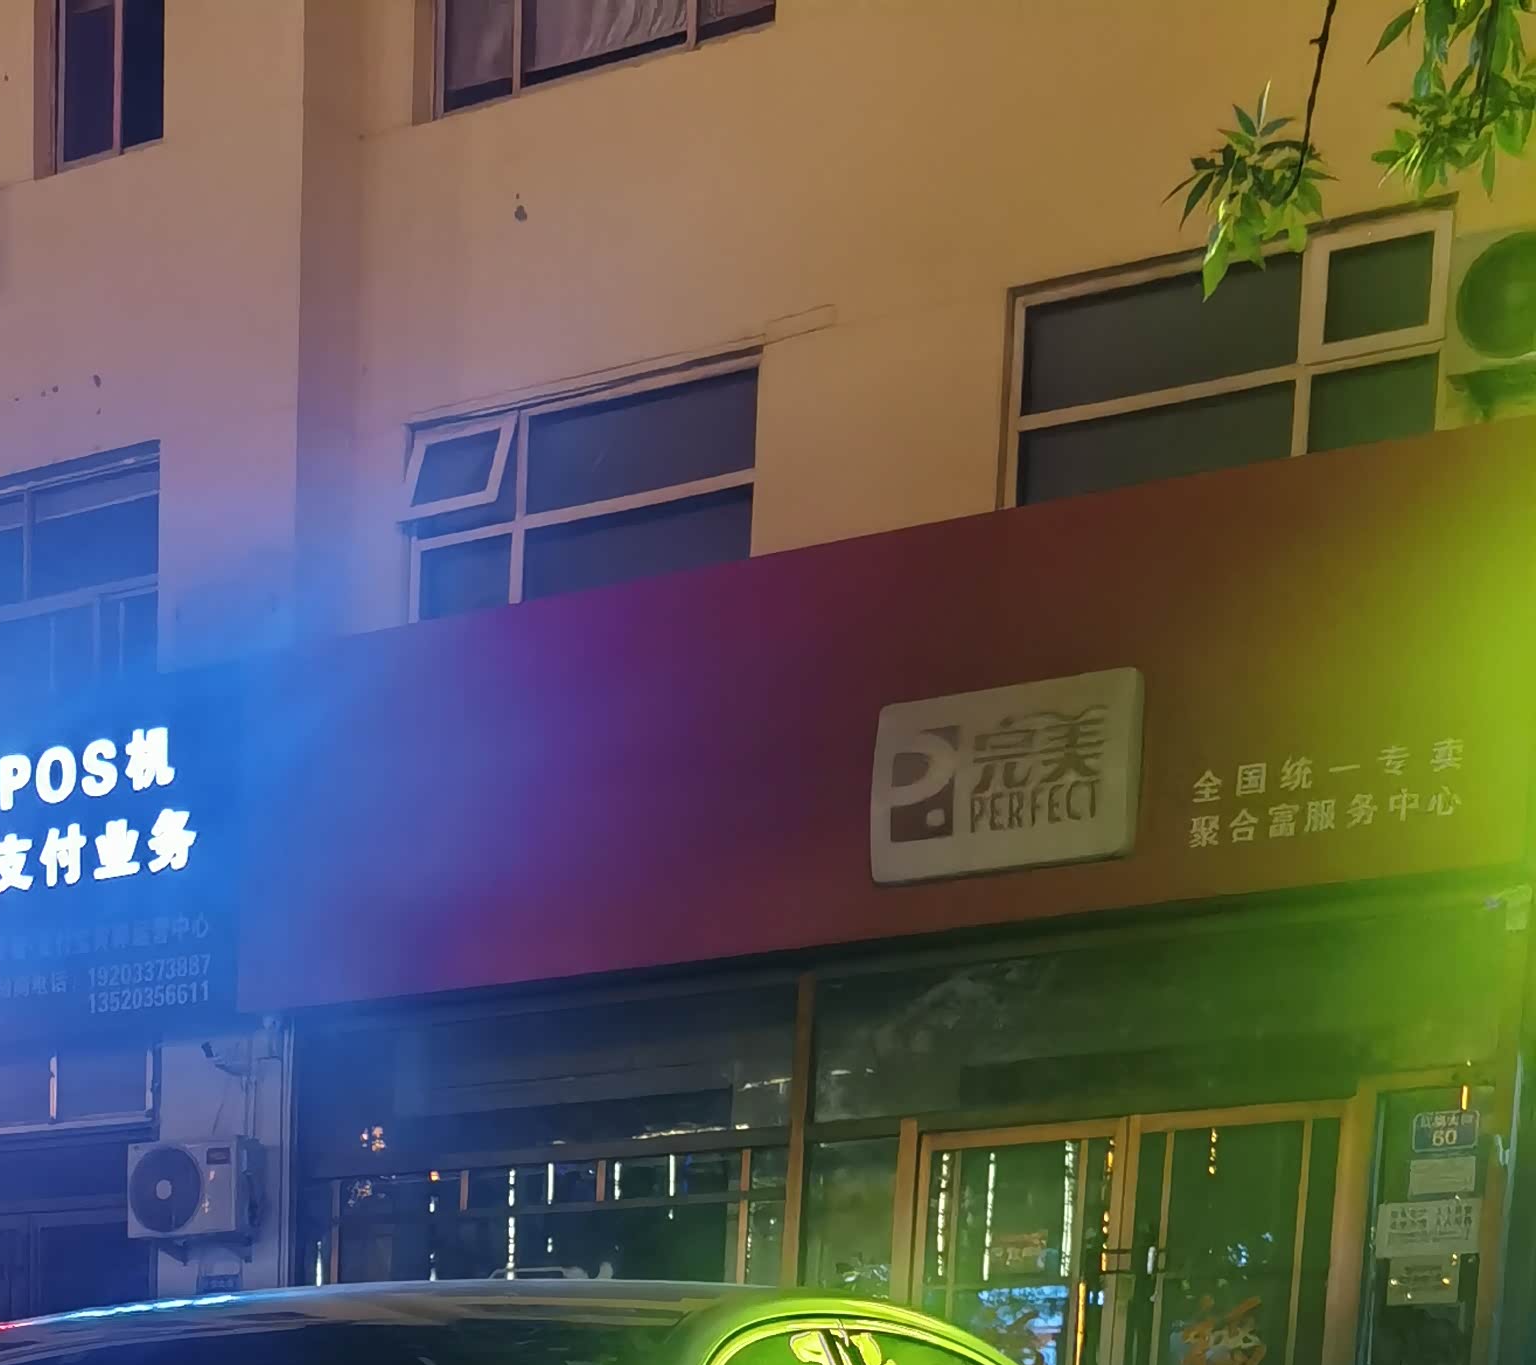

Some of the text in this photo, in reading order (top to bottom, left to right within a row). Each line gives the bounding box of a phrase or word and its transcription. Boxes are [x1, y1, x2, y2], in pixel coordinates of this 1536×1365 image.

[0, 726, 175, 811] POS机
[1192, 737, 1465, 803] 全国统一专卖
[970, 779, 1101, 833] PERFECT
[1188, 785, 1463, 848] 聚合富服务中心
[1432, 1129, 1457, 1146] 60
